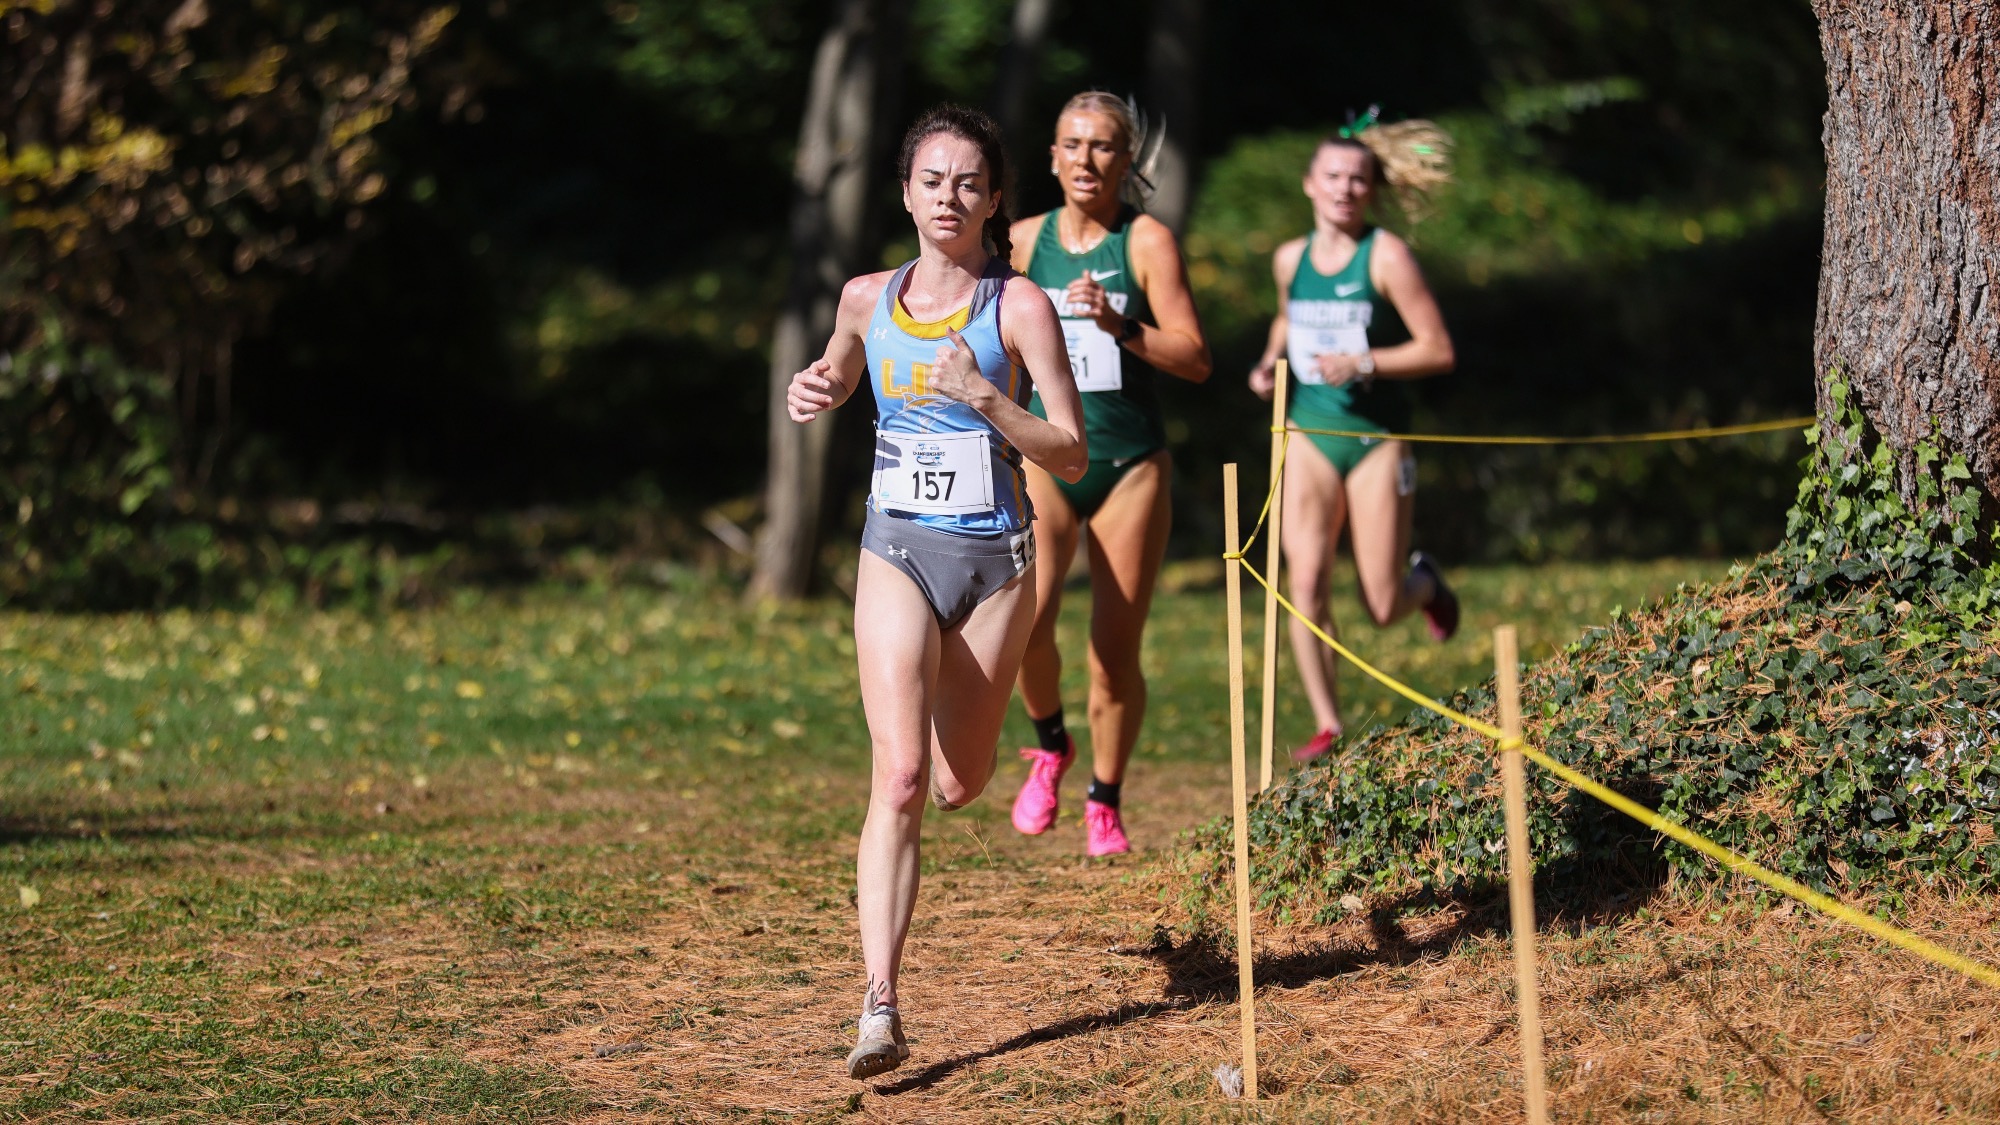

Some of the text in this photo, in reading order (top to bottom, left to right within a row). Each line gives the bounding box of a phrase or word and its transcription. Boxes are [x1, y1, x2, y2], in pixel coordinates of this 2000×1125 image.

[881, 358, 941, 398] LI
[1069, 355, 1089, 378] 51
[912, 470, 957, 501] 157
